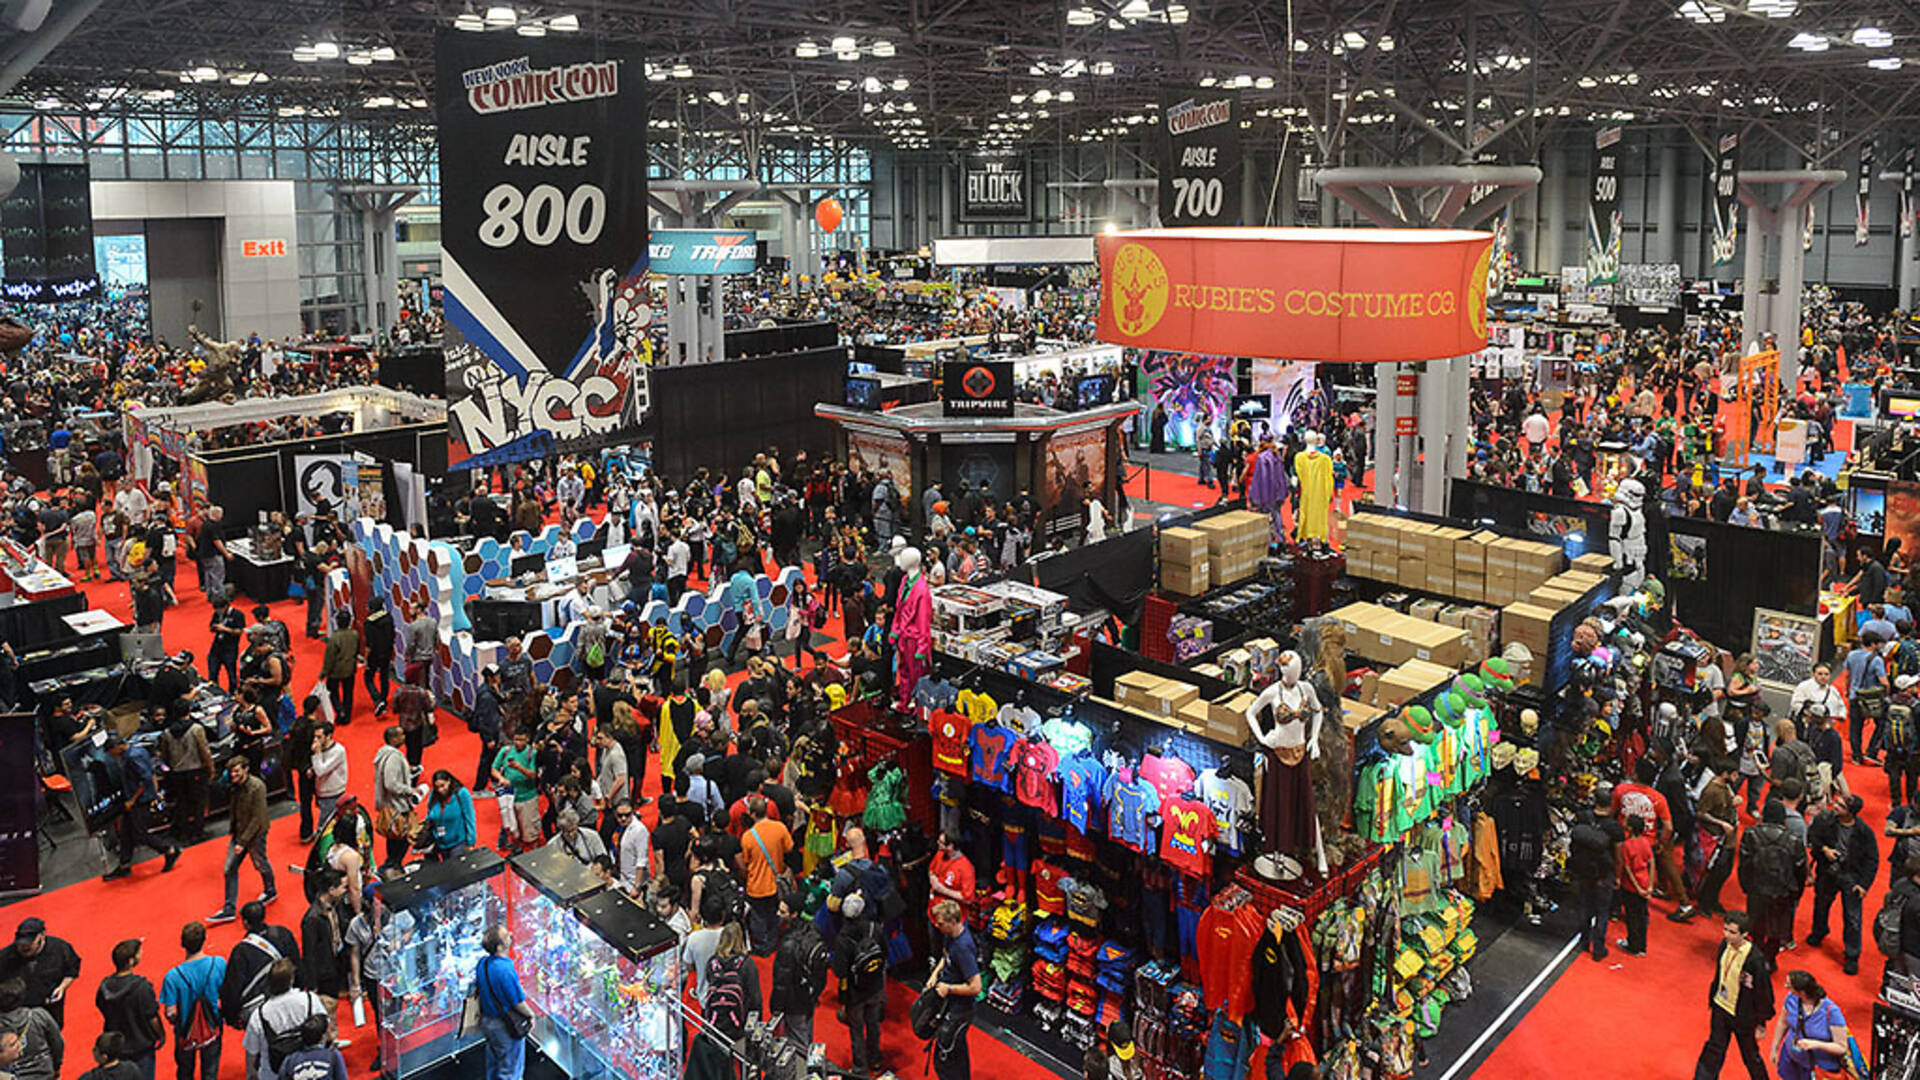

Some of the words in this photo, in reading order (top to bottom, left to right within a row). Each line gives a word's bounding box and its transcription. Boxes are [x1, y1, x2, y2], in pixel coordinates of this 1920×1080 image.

[464, 69, 492, 88] NEW
[493, 57, 529, 81] YORK
[472, 69, 561, 111] COMIC
[564, 62, 617, 98] CON
[504, 134, 591, 167] AISLE
[1181, 147, 1217, 167] AISLE
[986, 163, 1004, 173] THE
[968, 174, 1023, 202] BLOCK
[1172, 177, 1224, 218] 700
[1594, 176, 1617, 201] 500
[478, 183, 607, 248] 800
[243, 241, 285, 256] Exit
[1174, 284, 1276, 314] RUBIE'S
[1284, 289, 1424, 318] COSTUME
[449, 371, 620, 455] NYCC
[950, 400, 1008, 408] TRIPWIRE
